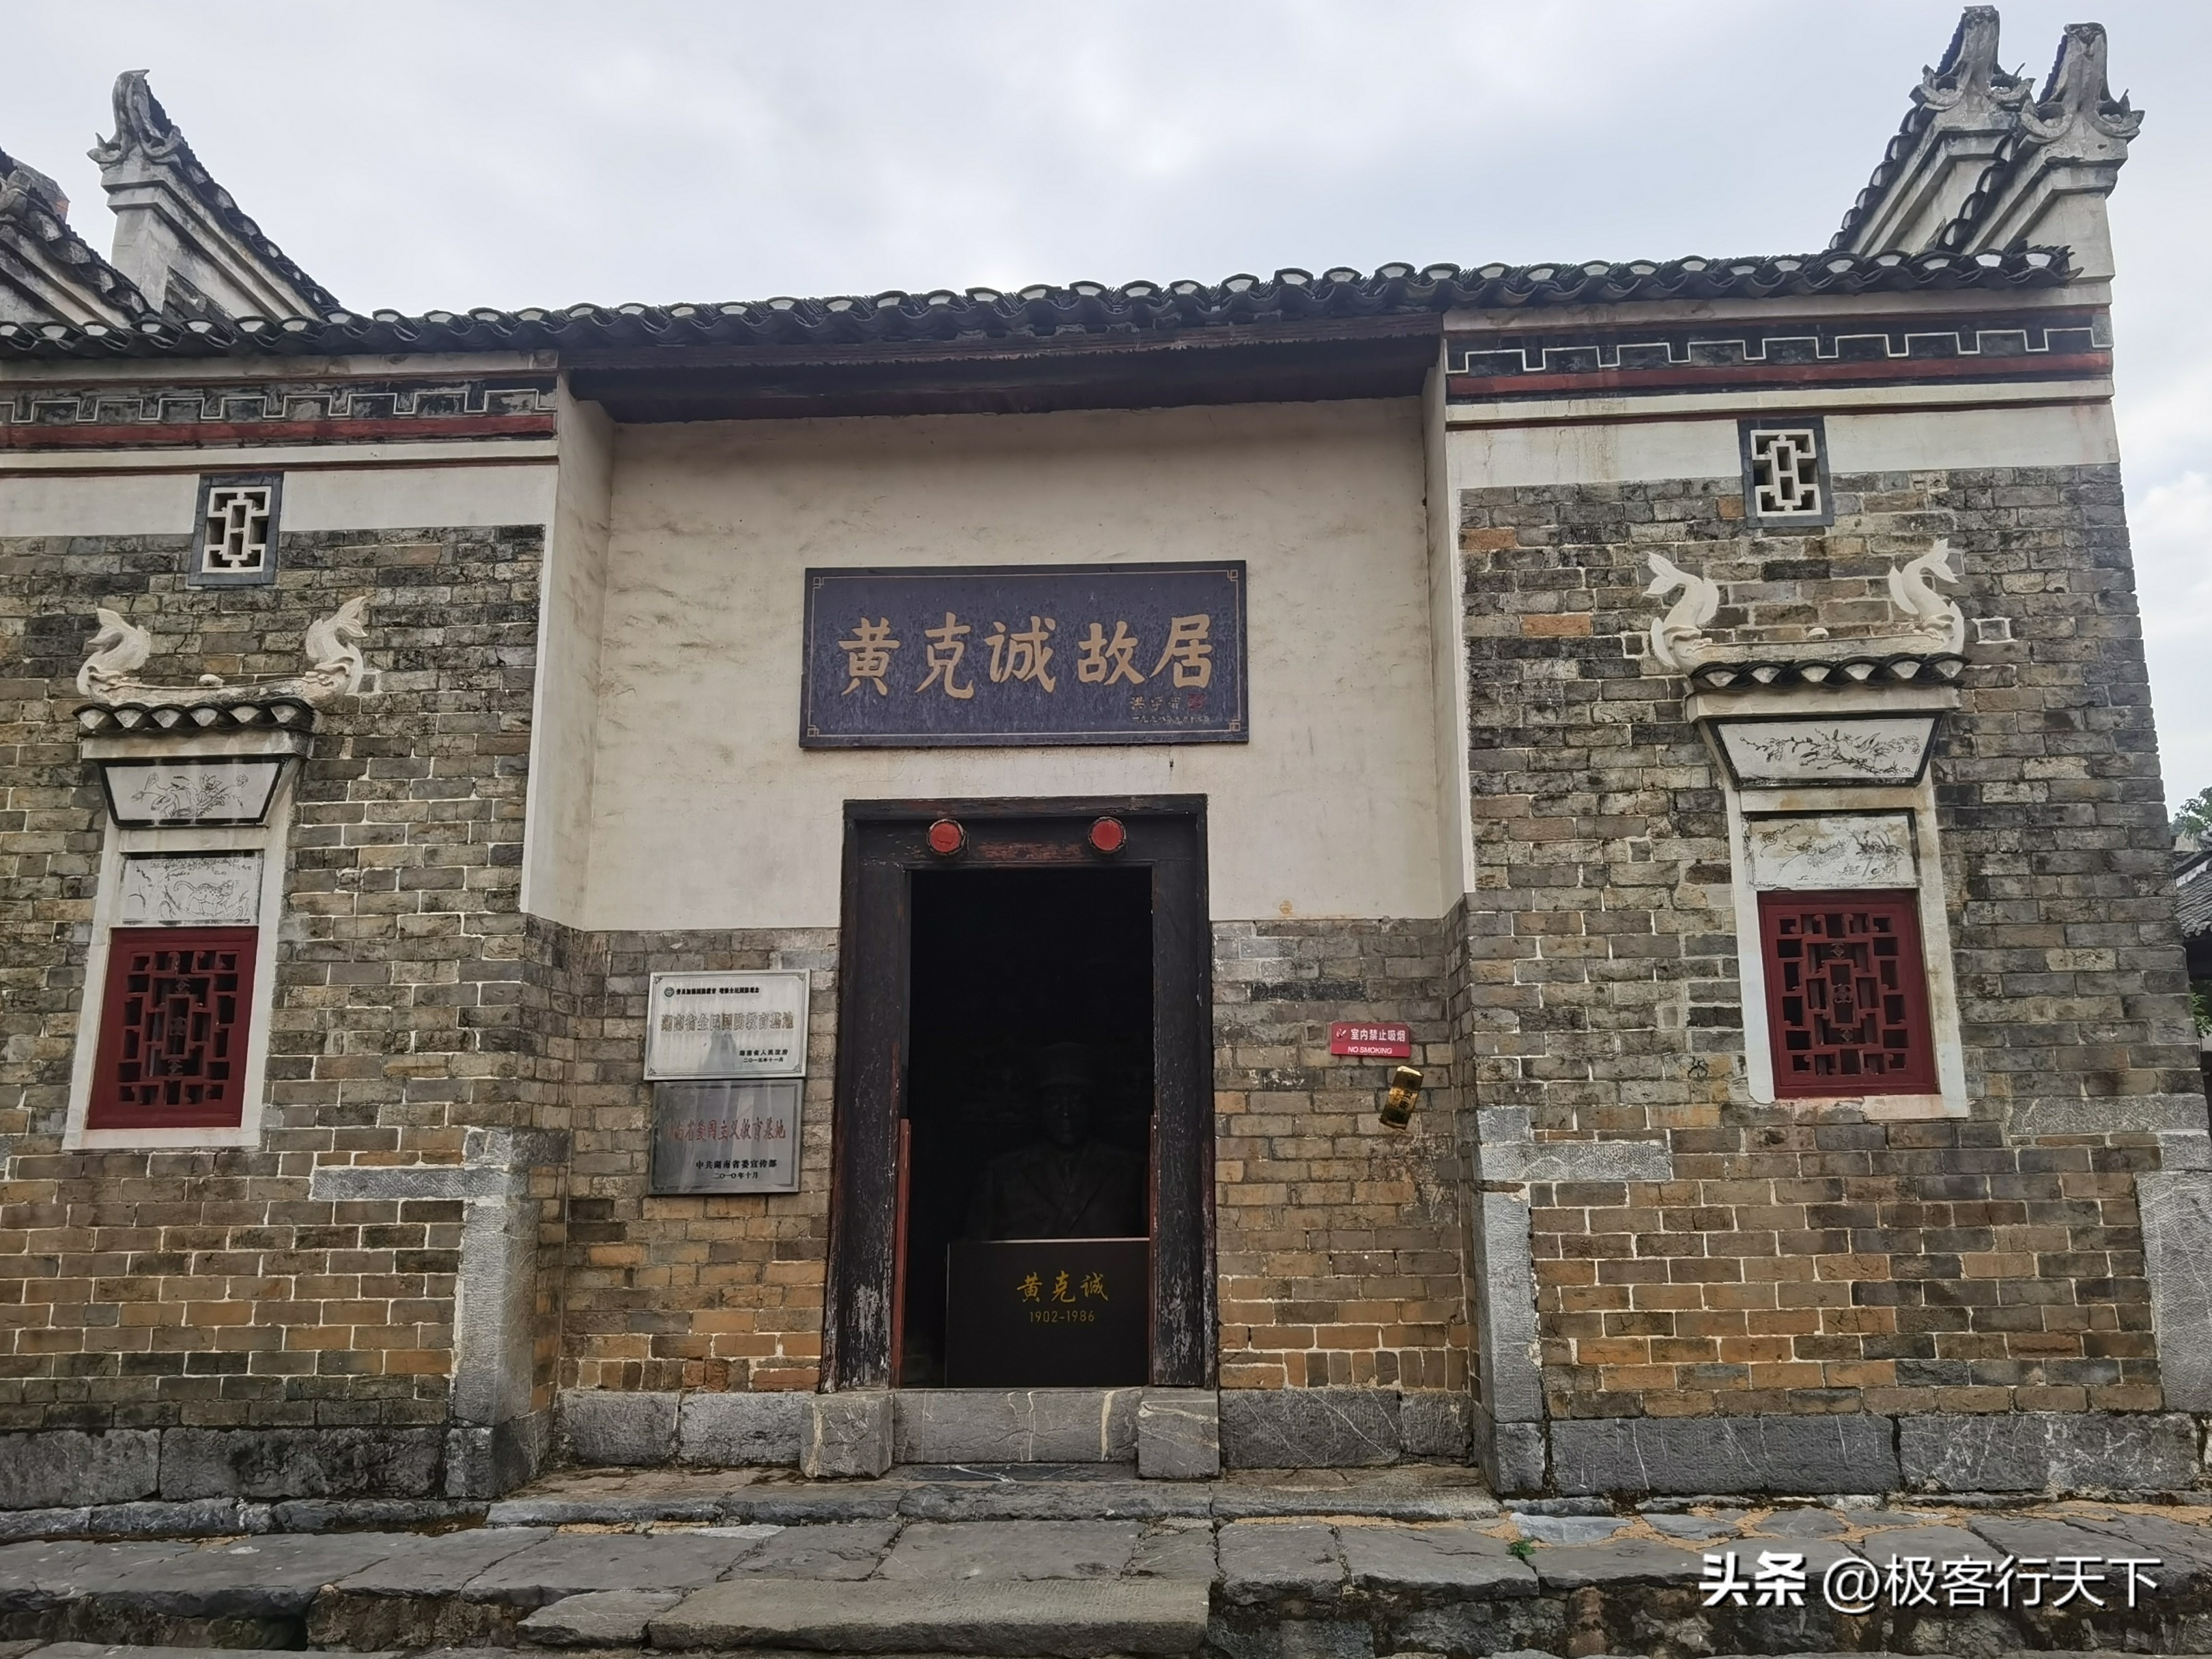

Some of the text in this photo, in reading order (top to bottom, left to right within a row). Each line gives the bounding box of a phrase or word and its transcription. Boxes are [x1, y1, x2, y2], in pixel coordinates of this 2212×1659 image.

[838, 612, 1213, 699] 黄克诚故居
[660, 1011, 794, 1032] 湖南省全民国防教育基地
[1350, 1027, 1406, 1043] 室内禁止吸烟
[1360, 1047, 1393, 1055] SMOKING
[696, 1159, 778, 1170] 中共湖南省委宣传部
[1030, 1309, 1095, 1323] 1902-1986
